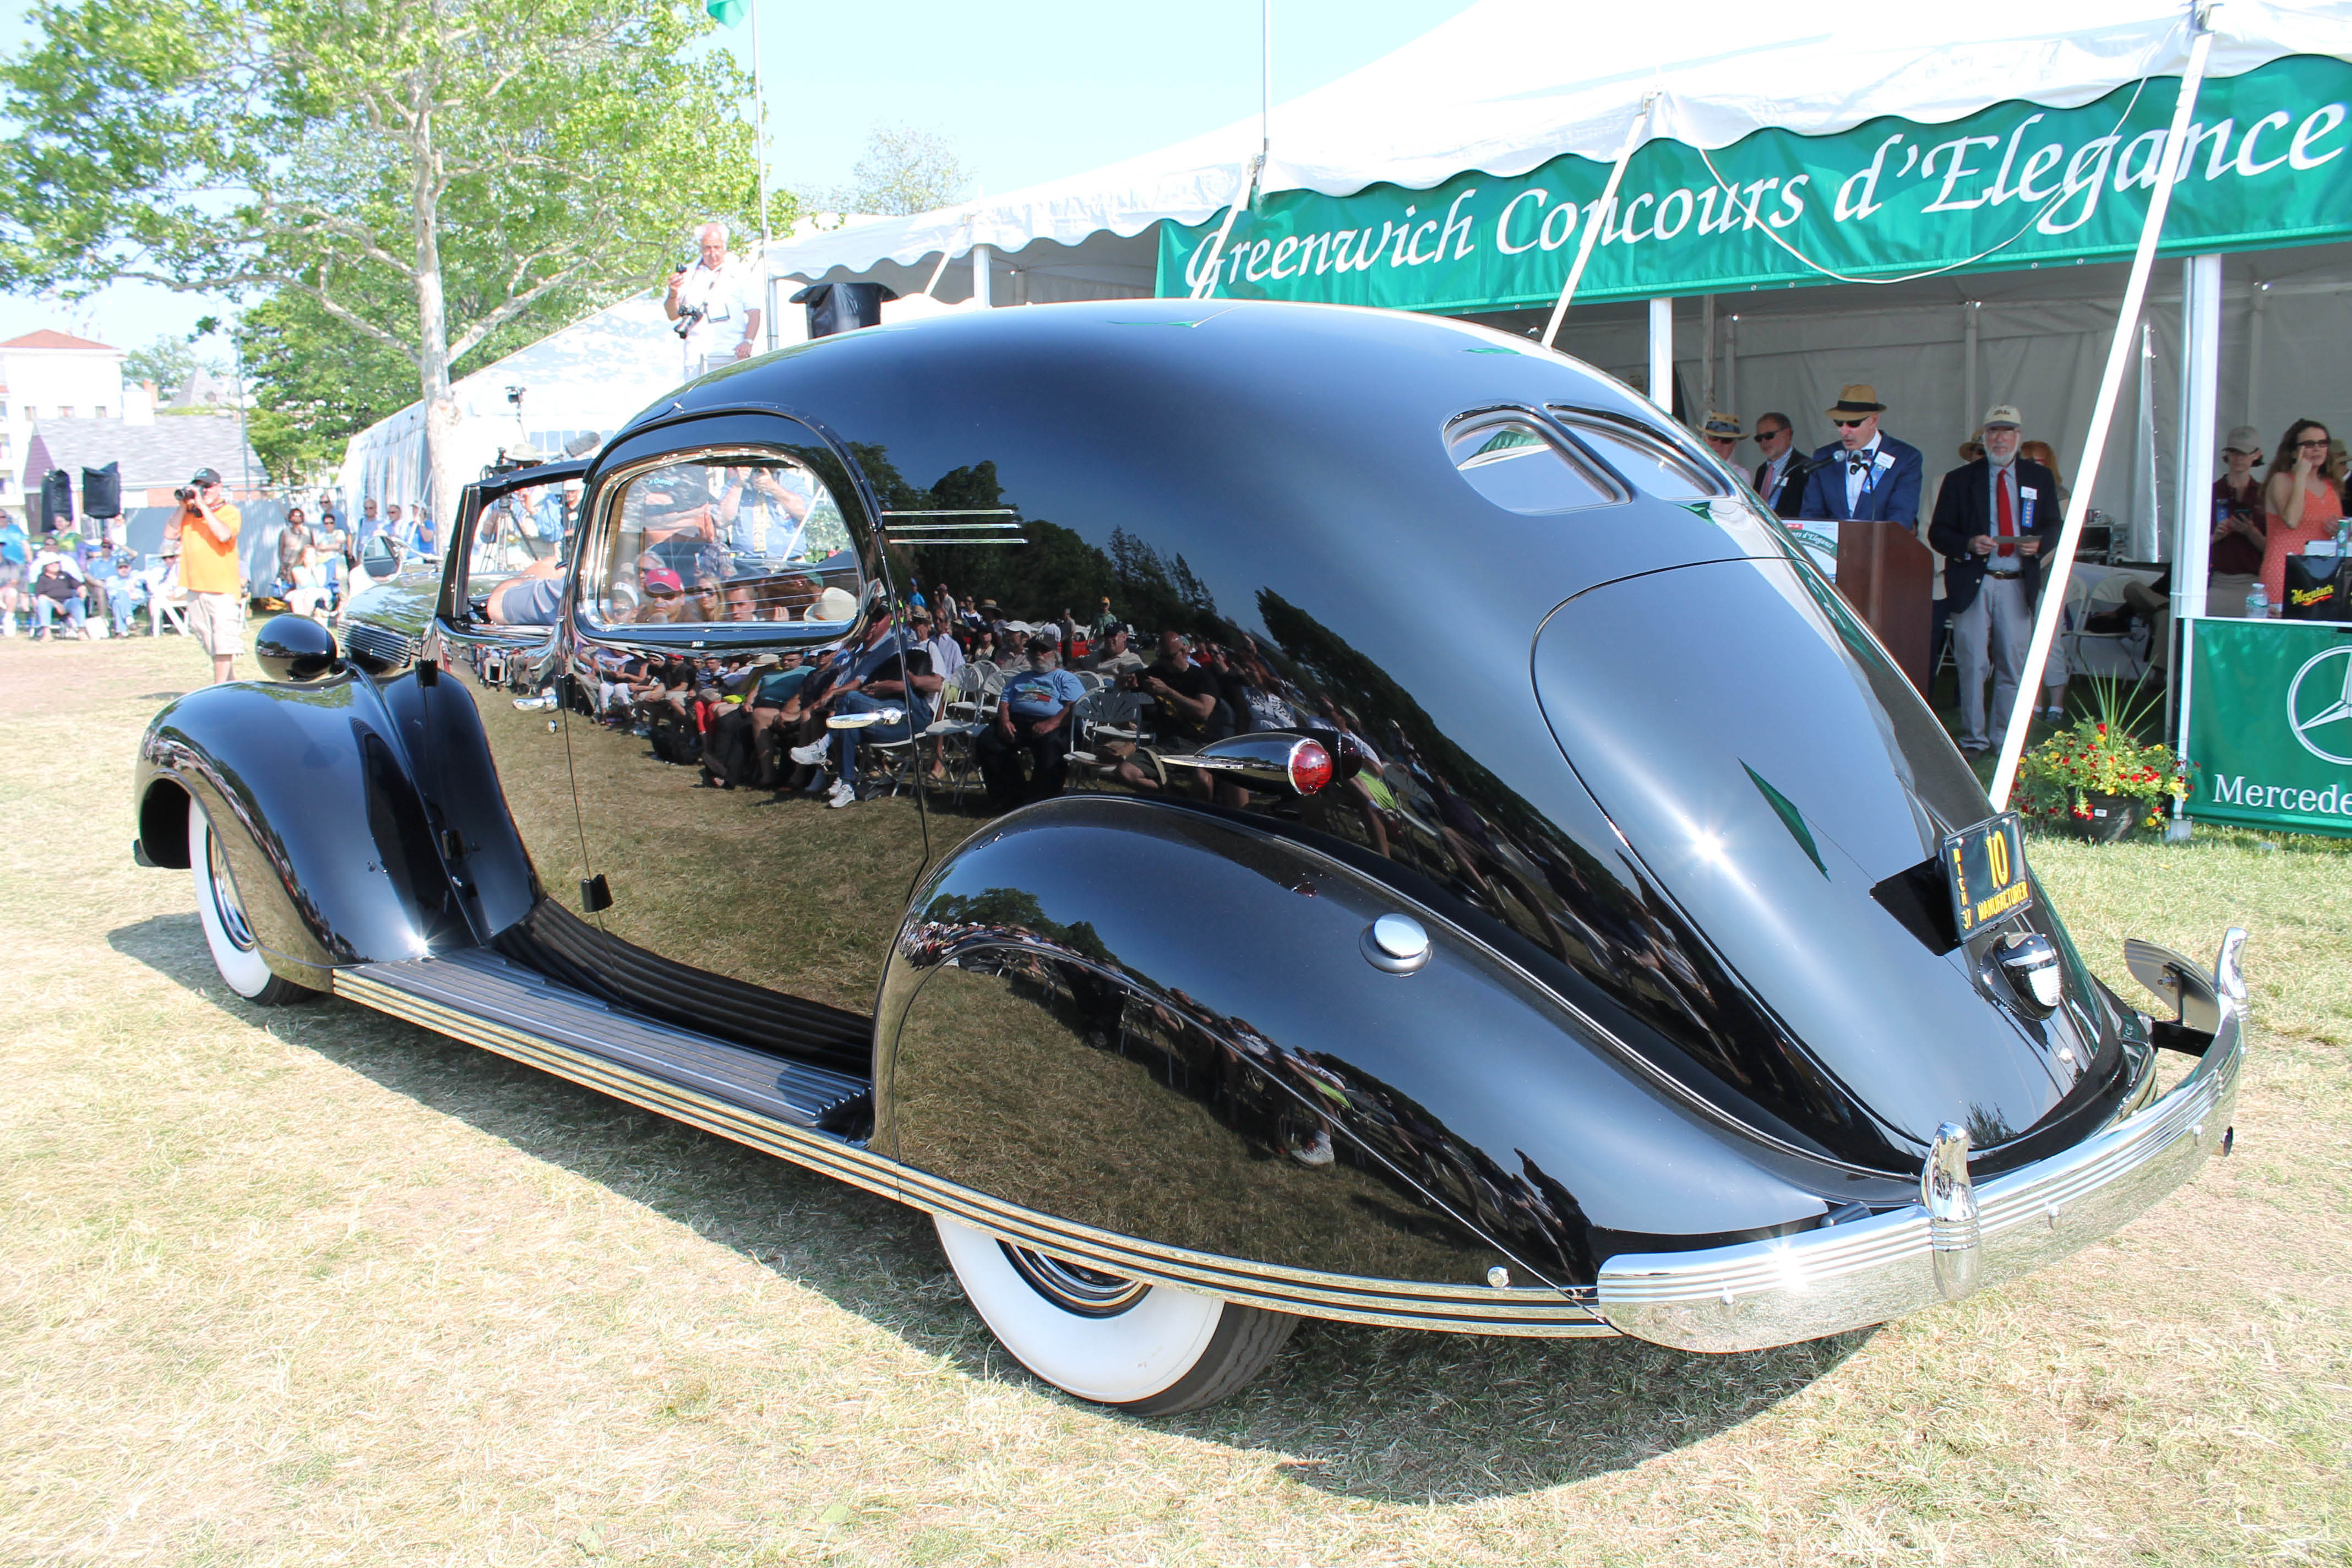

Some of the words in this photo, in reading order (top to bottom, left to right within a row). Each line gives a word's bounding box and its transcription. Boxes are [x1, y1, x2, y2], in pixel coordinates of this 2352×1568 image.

[1185, 188, 1476, 299] Greenwich
[1496, 174, 1810, 255] Concours
[1834, 102, 2345, 235] d'Elegance
[1986, 830, 2010, 889] 10
[1977, 881, 2029, 922] MANUFACTURER
